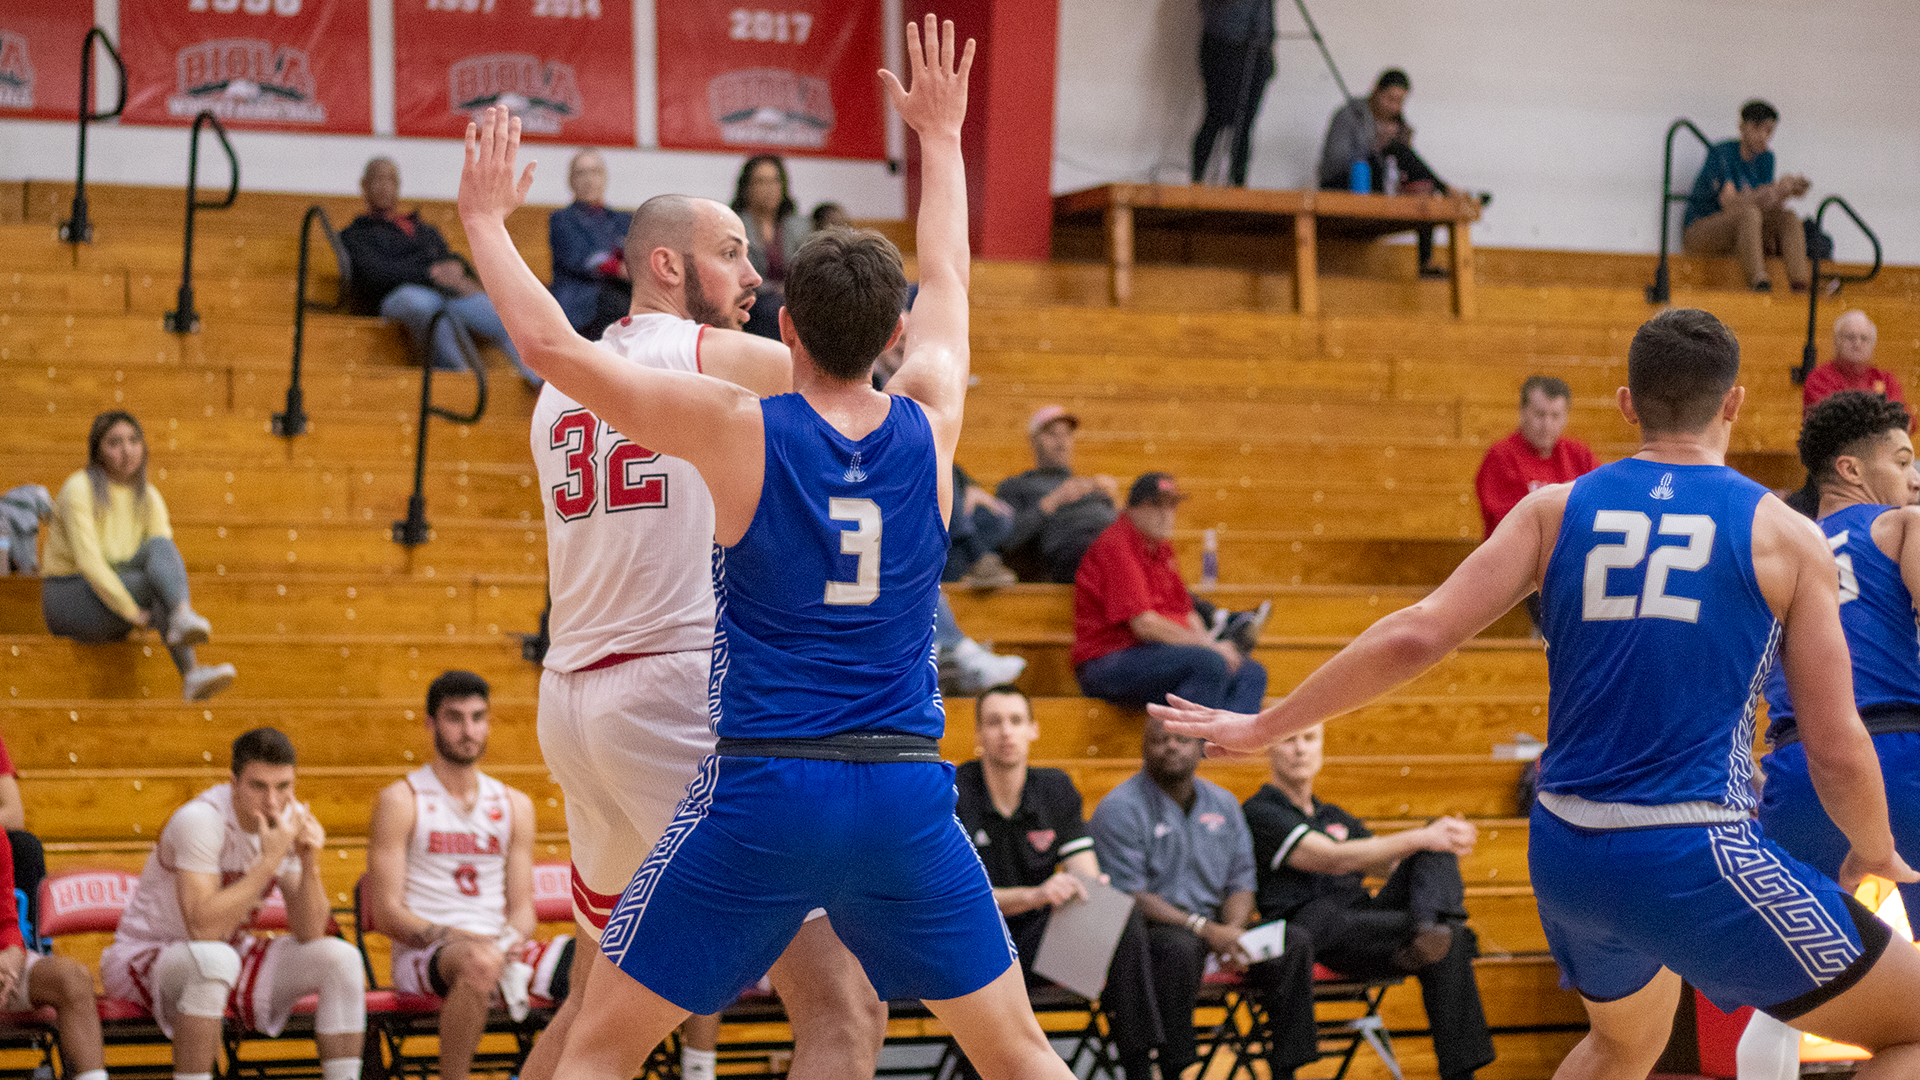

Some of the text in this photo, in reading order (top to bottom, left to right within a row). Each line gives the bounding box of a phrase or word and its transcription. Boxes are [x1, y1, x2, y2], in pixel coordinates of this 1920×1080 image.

[730, 8, 813, 44] 2017
[550, 407, 668, 523] 32
[823, 497, 882, 606] 3
[1582, 510, 1717, 623] 22
[428, 831, 501, 854] BIOLA
[50, 872, 140, 915] BIOL
